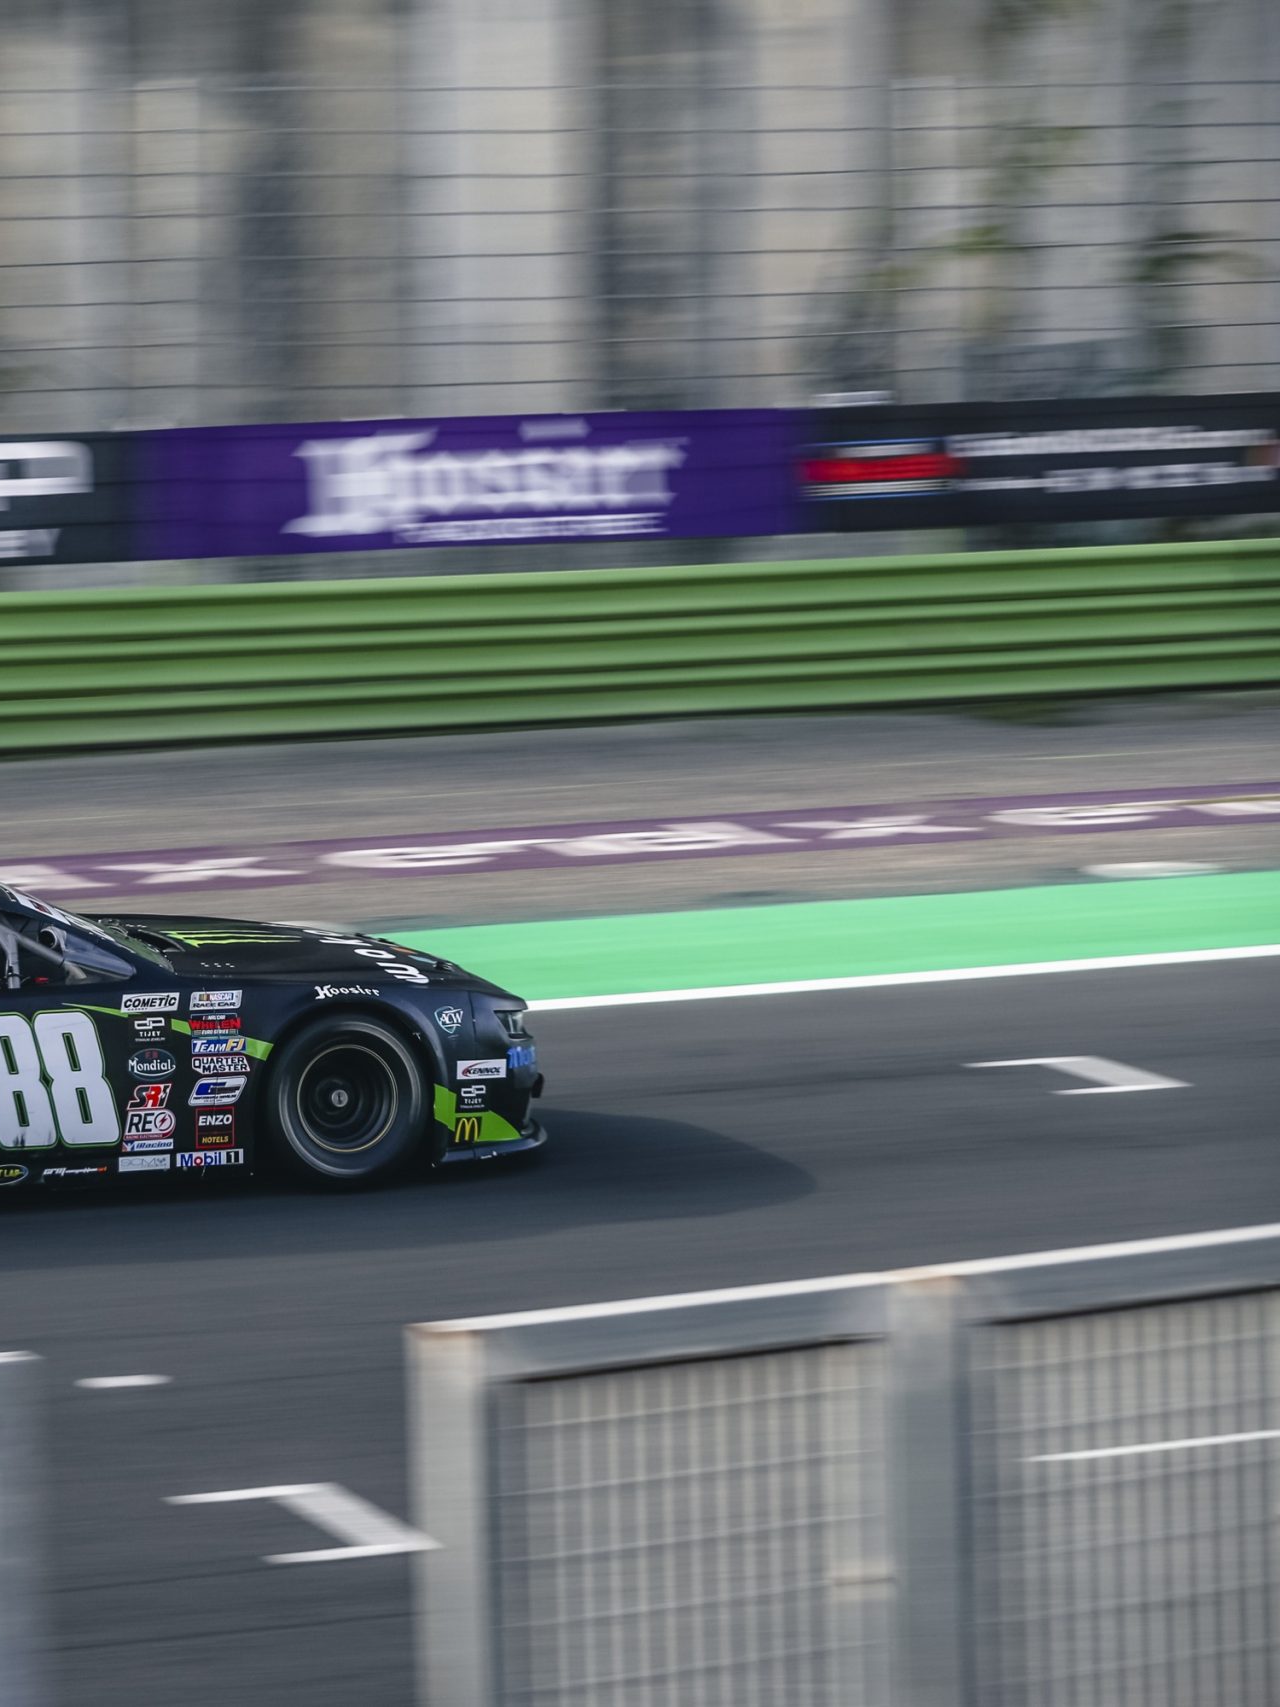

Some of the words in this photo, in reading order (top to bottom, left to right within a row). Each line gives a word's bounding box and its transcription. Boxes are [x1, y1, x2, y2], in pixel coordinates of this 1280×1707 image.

[209, 993, 233, 1001] NASCAR
[314, 984, 380, 1000] Hoosier
[128, 1057, 173, 1073] Mondial
[193, 1056, 245, 1069] QUARTER
[202, 1064, 248, 1075] MASTER
[198, 1114, 233, 1127] ENZO
[202, 1136, 229, 1144] HOTELS
[179, 1152, 223, 1168] Mobil
